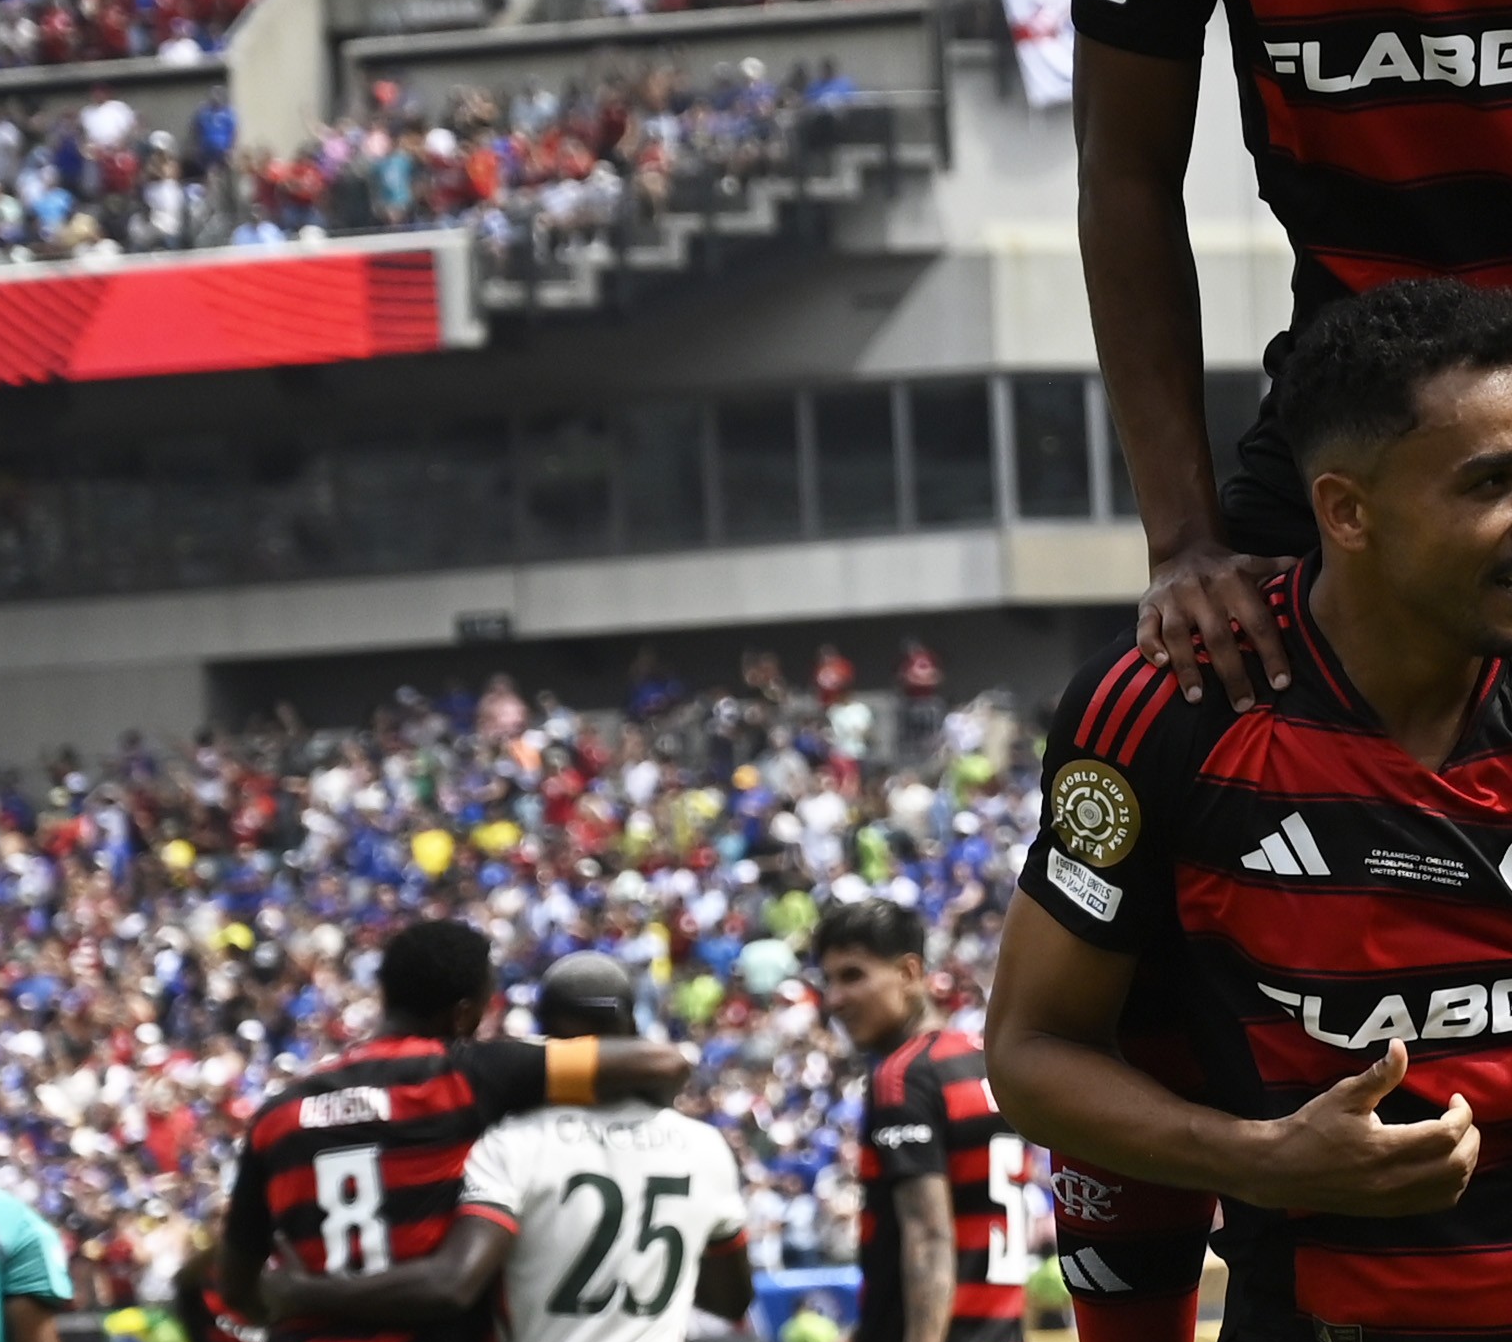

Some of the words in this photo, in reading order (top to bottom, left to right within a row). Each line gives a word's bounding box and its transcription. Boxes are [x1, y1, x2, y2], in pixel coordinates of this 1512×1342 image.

[1059, 771, 1098, 794] WORLD
[1102, 778, 1124, 803] CUP
[1119, 806, 1130, 823] 25
[1071, 835, 1104, 860] FIFA
[1108, 828, 1128, 851] USA
[1055, 854, 1088, 884] FOOTBALL
[1396, 869, 1422, 880] STATES
[1421, 874, 1432, 882] OF
[313, 1141, 389, 1278] 8
[546, 1171, 691, 1317] 25
